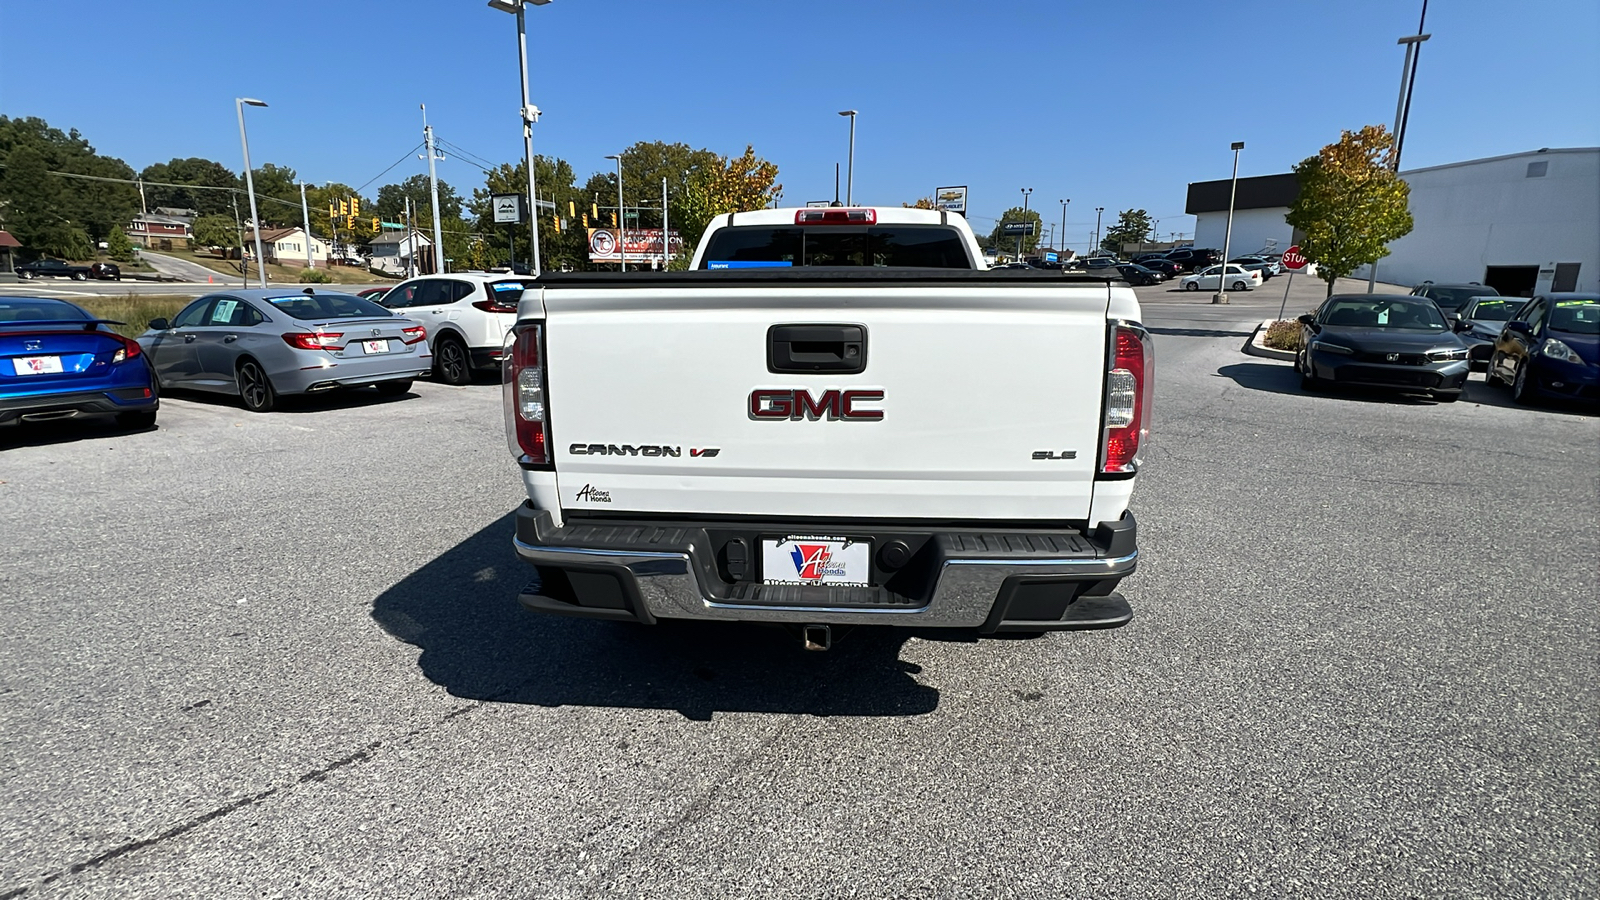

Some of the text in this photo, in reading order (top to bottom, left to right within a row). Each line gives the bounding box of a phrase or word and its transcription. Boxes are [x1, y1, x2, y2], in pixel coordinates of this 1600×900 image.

[618, 236, 683, 244] RANS4MAON
[748, 389, 884, 421] GMC
[569, 443, 681, 457] CANYON
[1032, 450, 1077, 460] SLE
[576, 483, 610, 502] Altoona
[590, 495, 612, 503] Honda
[818, 567, 846, 576] Honda
